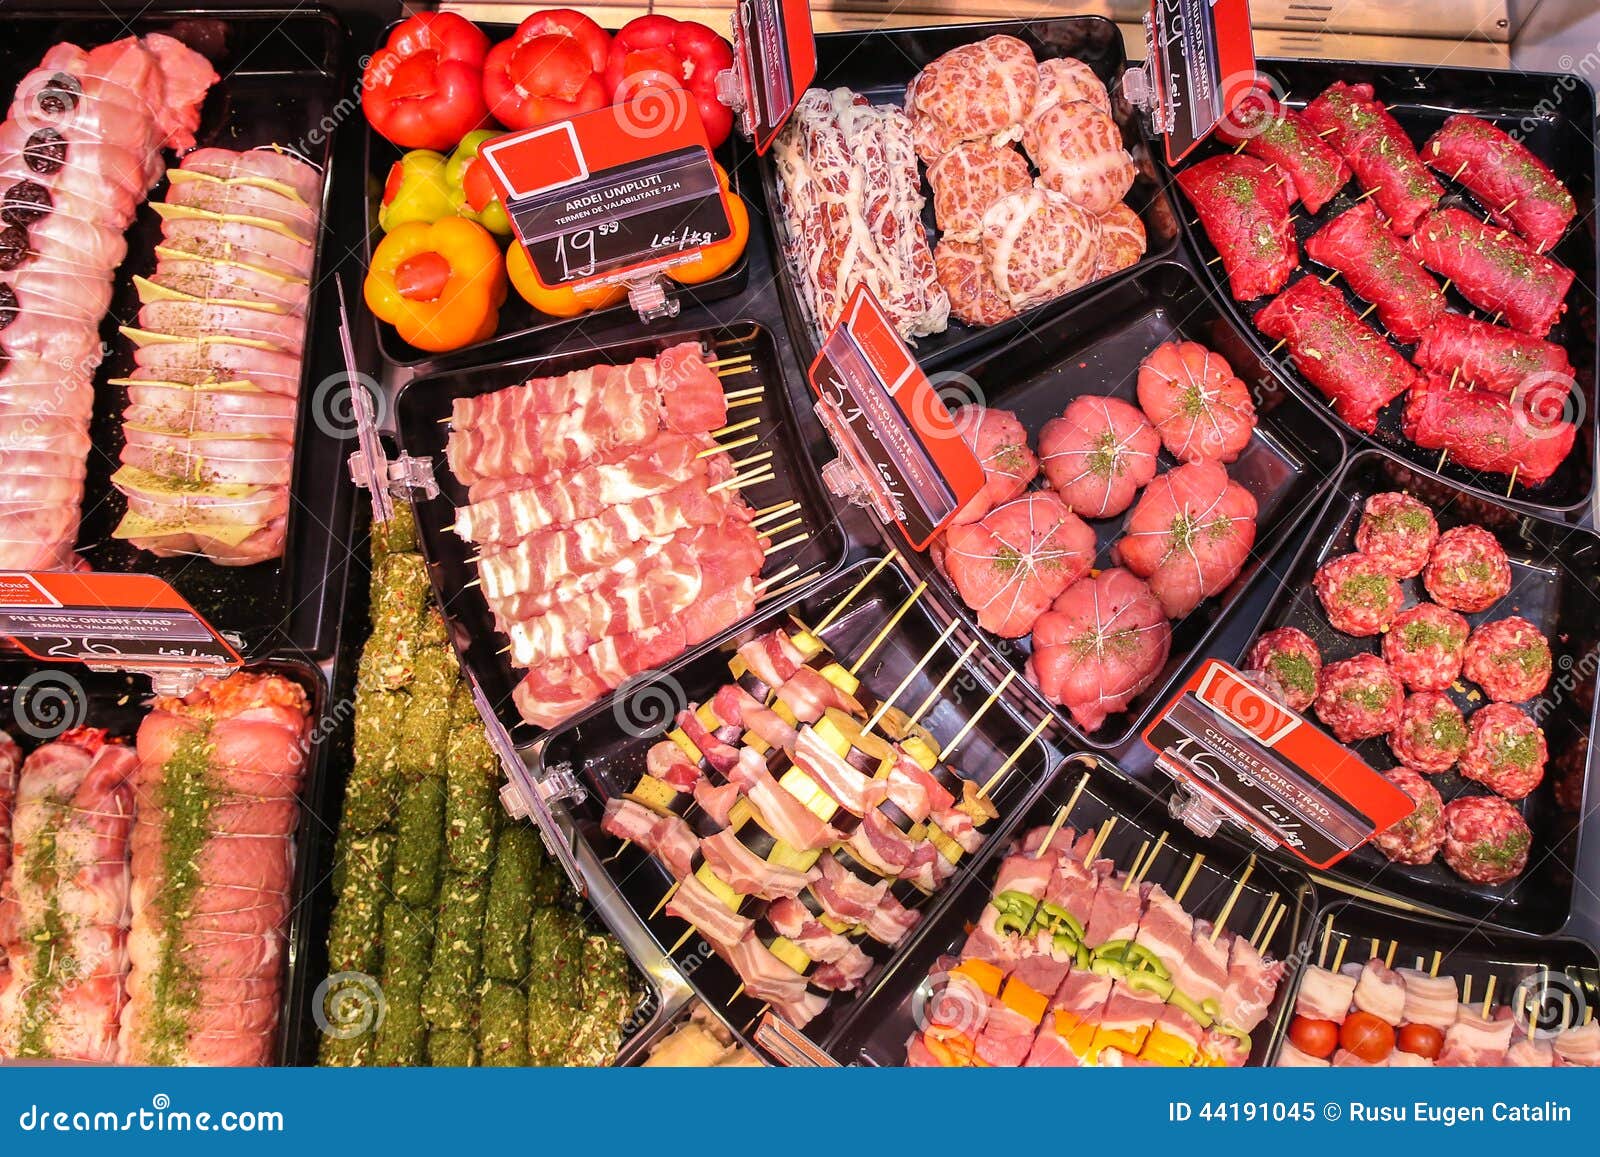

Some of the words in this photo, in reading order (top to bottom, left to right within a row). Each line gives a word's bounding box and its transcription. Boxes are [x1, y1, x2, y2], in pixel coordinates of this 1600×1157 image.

[1190, 29, 1199, 81] VALABILITATE
[1193, 1, 1202, 49] RULADA
[1198, 50, 1209, 100] MANZAT
[555, 211, 591, 225] TERMEN
[592, 206, 604, 214] DE
[604, 189, 661, 210] VALABILITATE
[662, 185, 672, 193] 72
[566, 194, 603, 212] ARDEI
[605, 175, 662, 199] UMPLUTI
[555, 230, 596, 281] 19
[850, 369, 870, 403] TERMEN
[879, 415, 911, 468] VALABILITATE
[39, 616, 78, 624] PORC
[79, 617, 129, 625] ORLOFF
[134, 619, 176, 627] TRAD.
[1203, 737, 1238, 762] TERMEN
[1237, 761, 1249, 770] DE
[1251, 769, 1306, 811] VALABILITATE
[1306, 807, 1316, 817] 72
[1205, 728, 1260, 768] CHIFTELE
[1261, 767, 1296, 793] PORC
[1297, 792, 1331, 820] TRAD.
